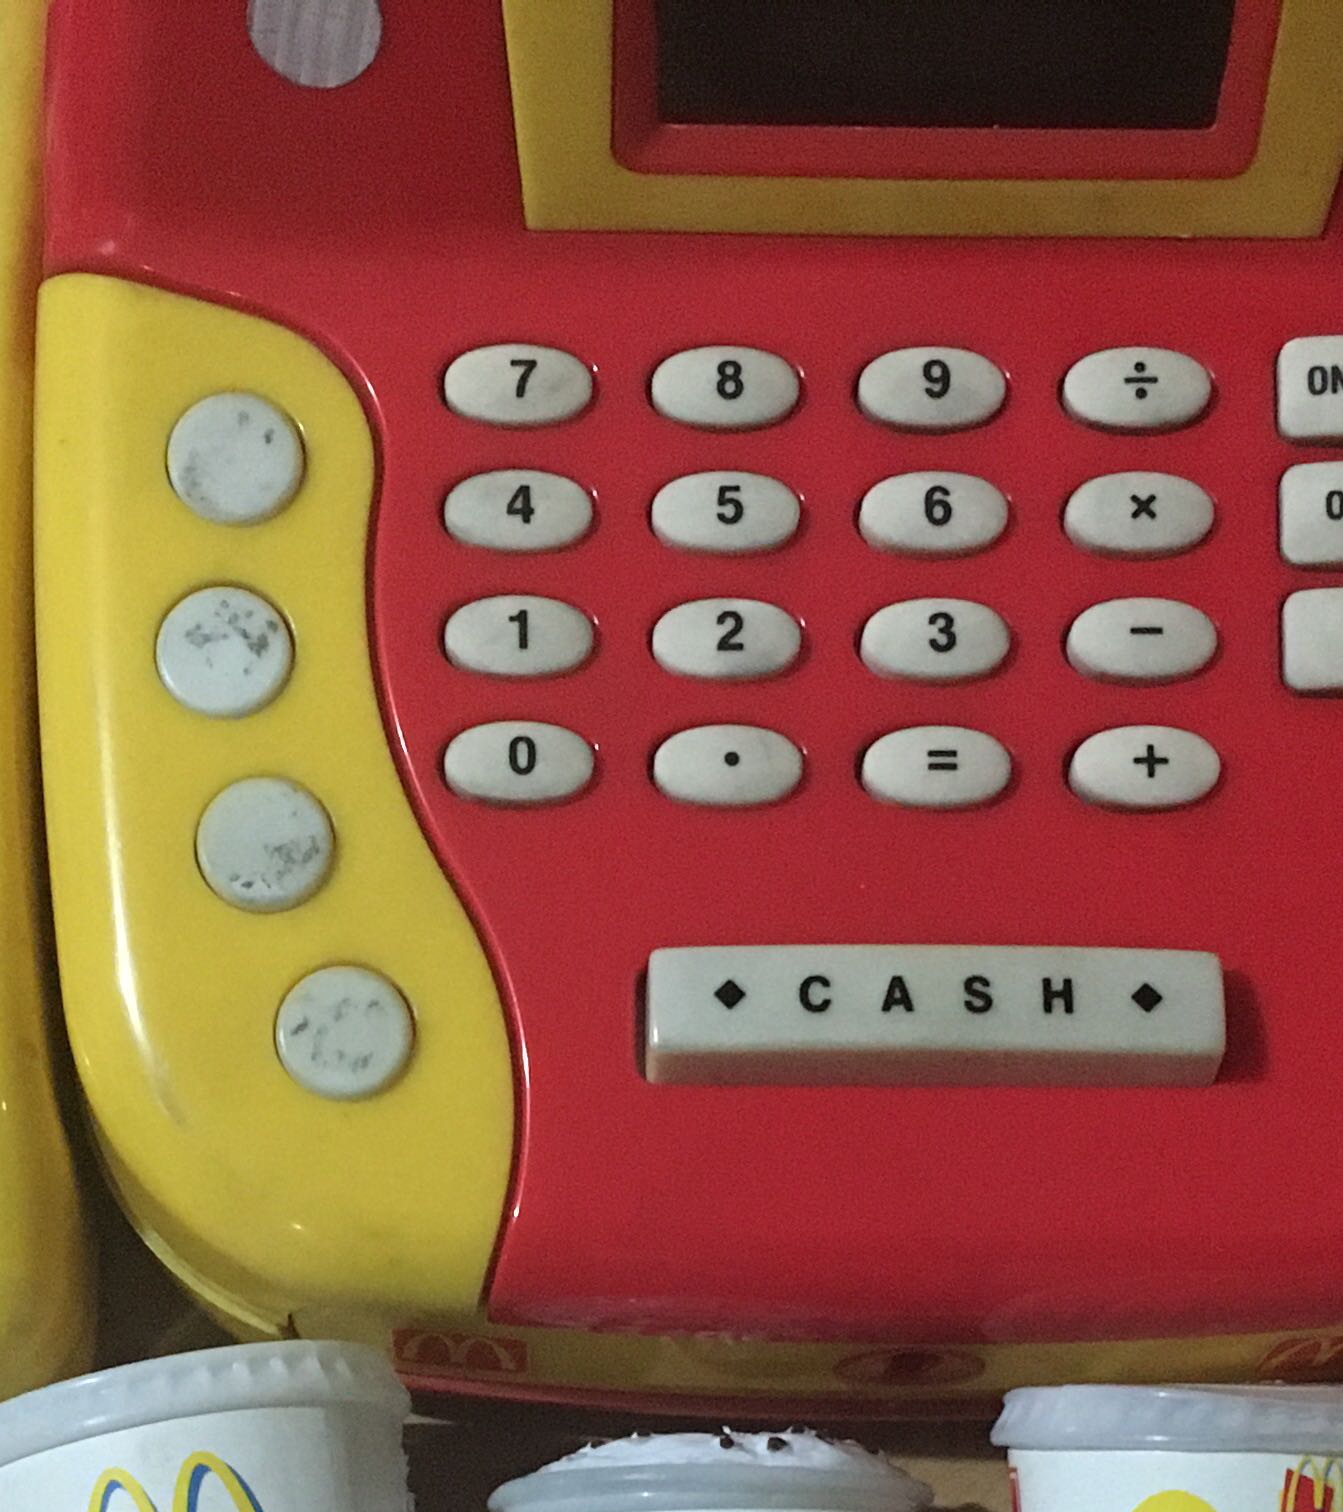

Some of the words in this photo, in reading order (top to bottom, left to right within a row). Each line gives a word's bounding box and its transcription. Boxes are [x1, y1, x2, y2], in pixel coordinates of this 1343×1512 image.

[509, 359, 538, 399] 7
[716, 359, 744, 400] 8
[922, 359, 951, 399] 9
[506, 484, 535, 524] 4
[716, 485, 744, 525] 5
[923, 485, 953, 526] 6
[508, 610, 530, 650] 1
[716, 610, 744, 652] 2
[928, 612, 957, 653] 3
[508, 736, 537, 776] 0
[798, 974, 1074, 1014] CASH
